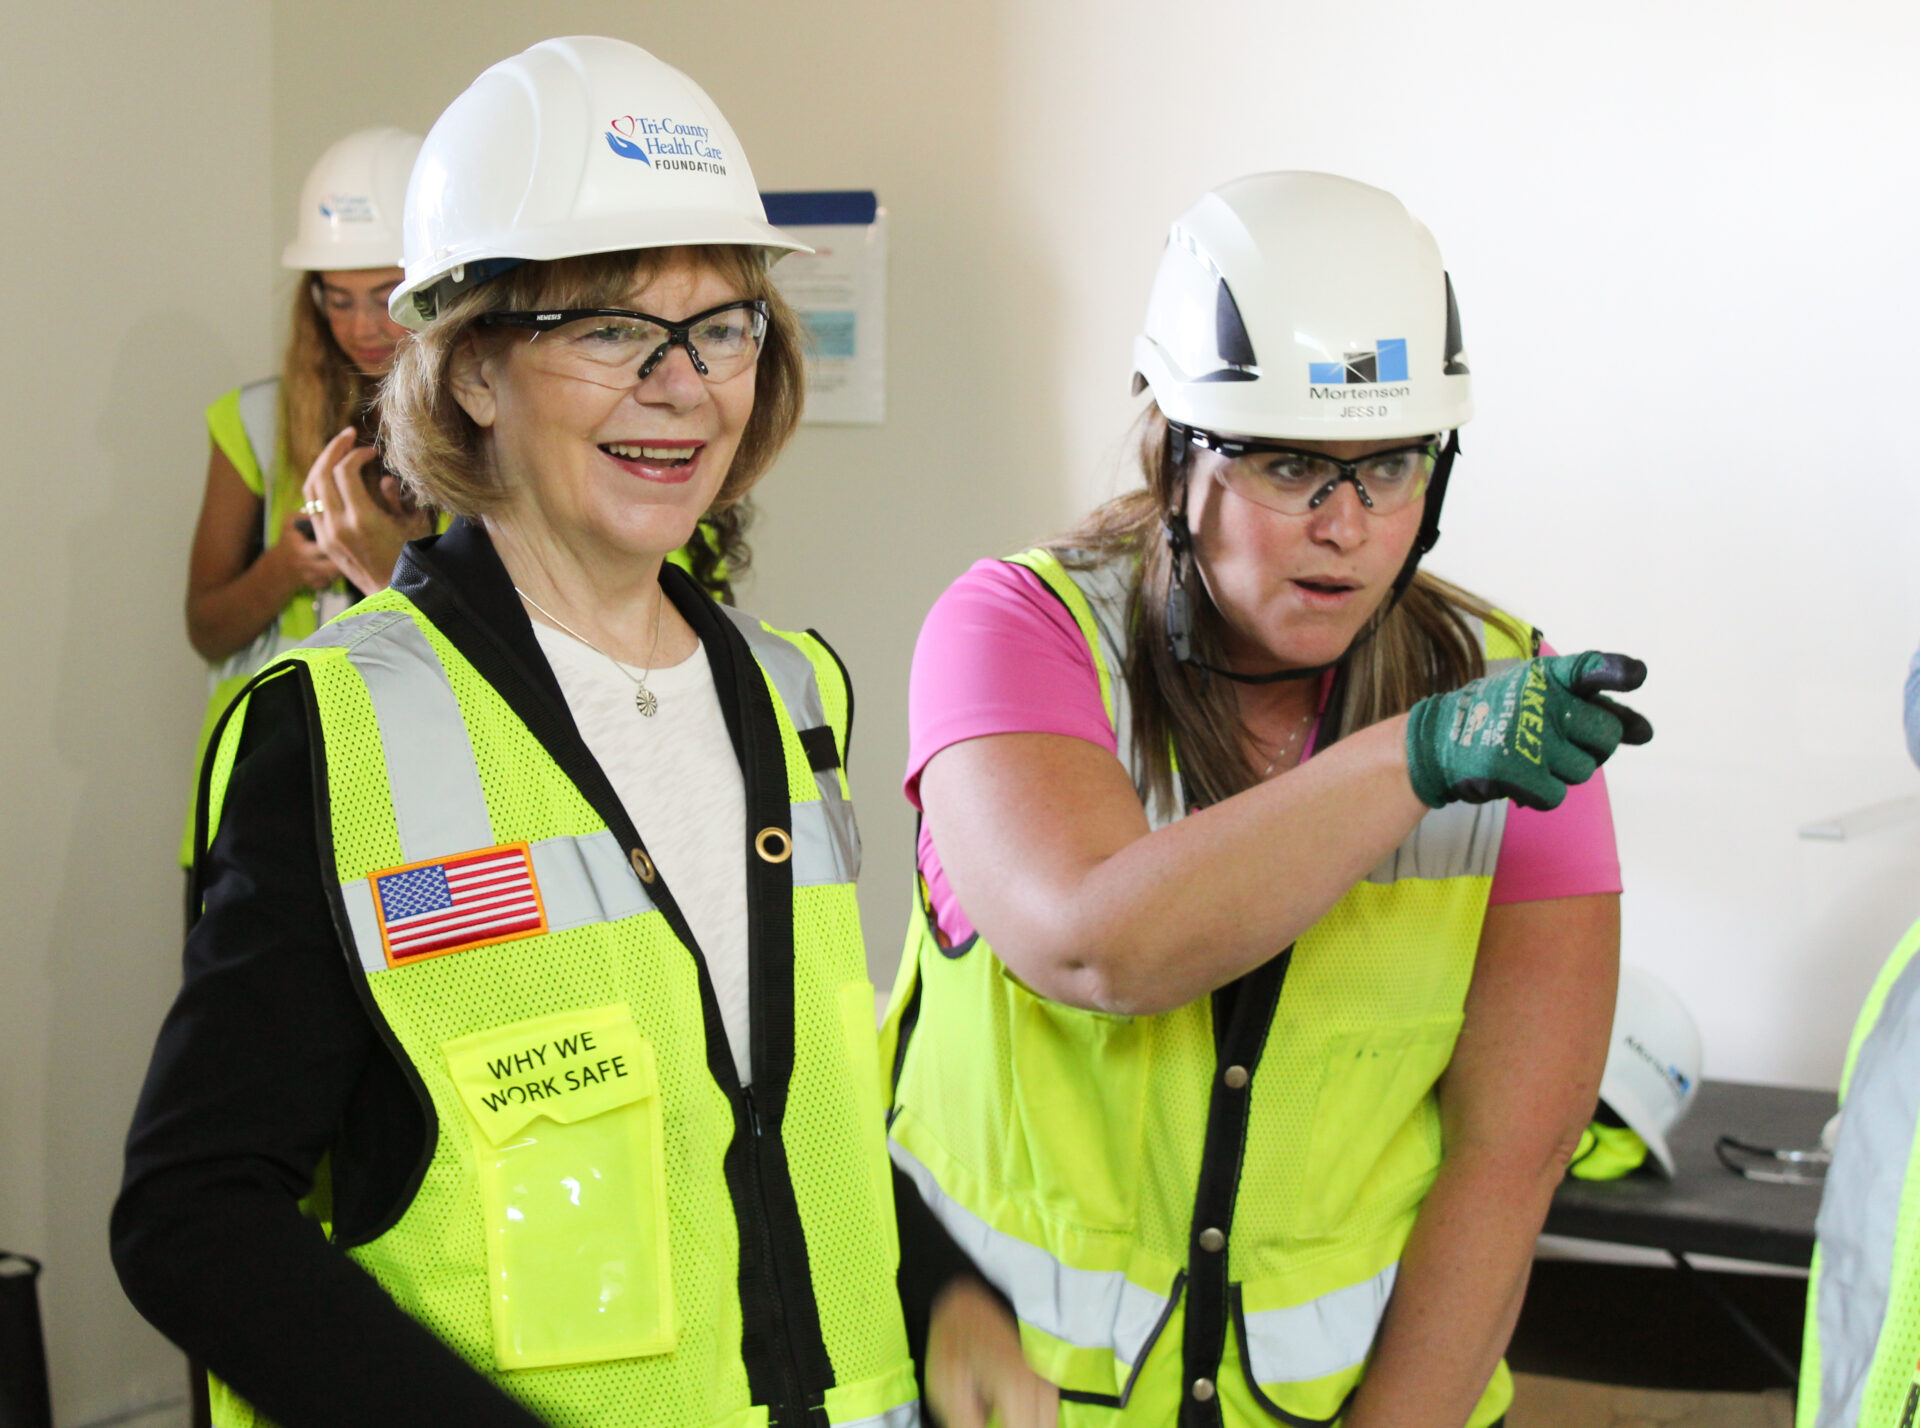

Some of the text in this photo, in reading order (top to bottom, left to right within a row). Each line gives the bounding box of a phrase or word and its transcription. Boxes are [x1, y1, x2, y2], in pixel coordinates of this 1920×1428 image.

[635, 118, 709, 143] Tri-County
[645, 137, 723, 160] Health Care
[655, 159, 727, 176] FOUNDATION
[536, 313, 562, 321] NEMESIS
[1309, 386, 1411, 400] Mortenson
[1340, 405, 1388, 418] JESS D
[487, 1031, 597, 1080] WHY WE
[481, 1055, 628, 1112] WORK SAFE
